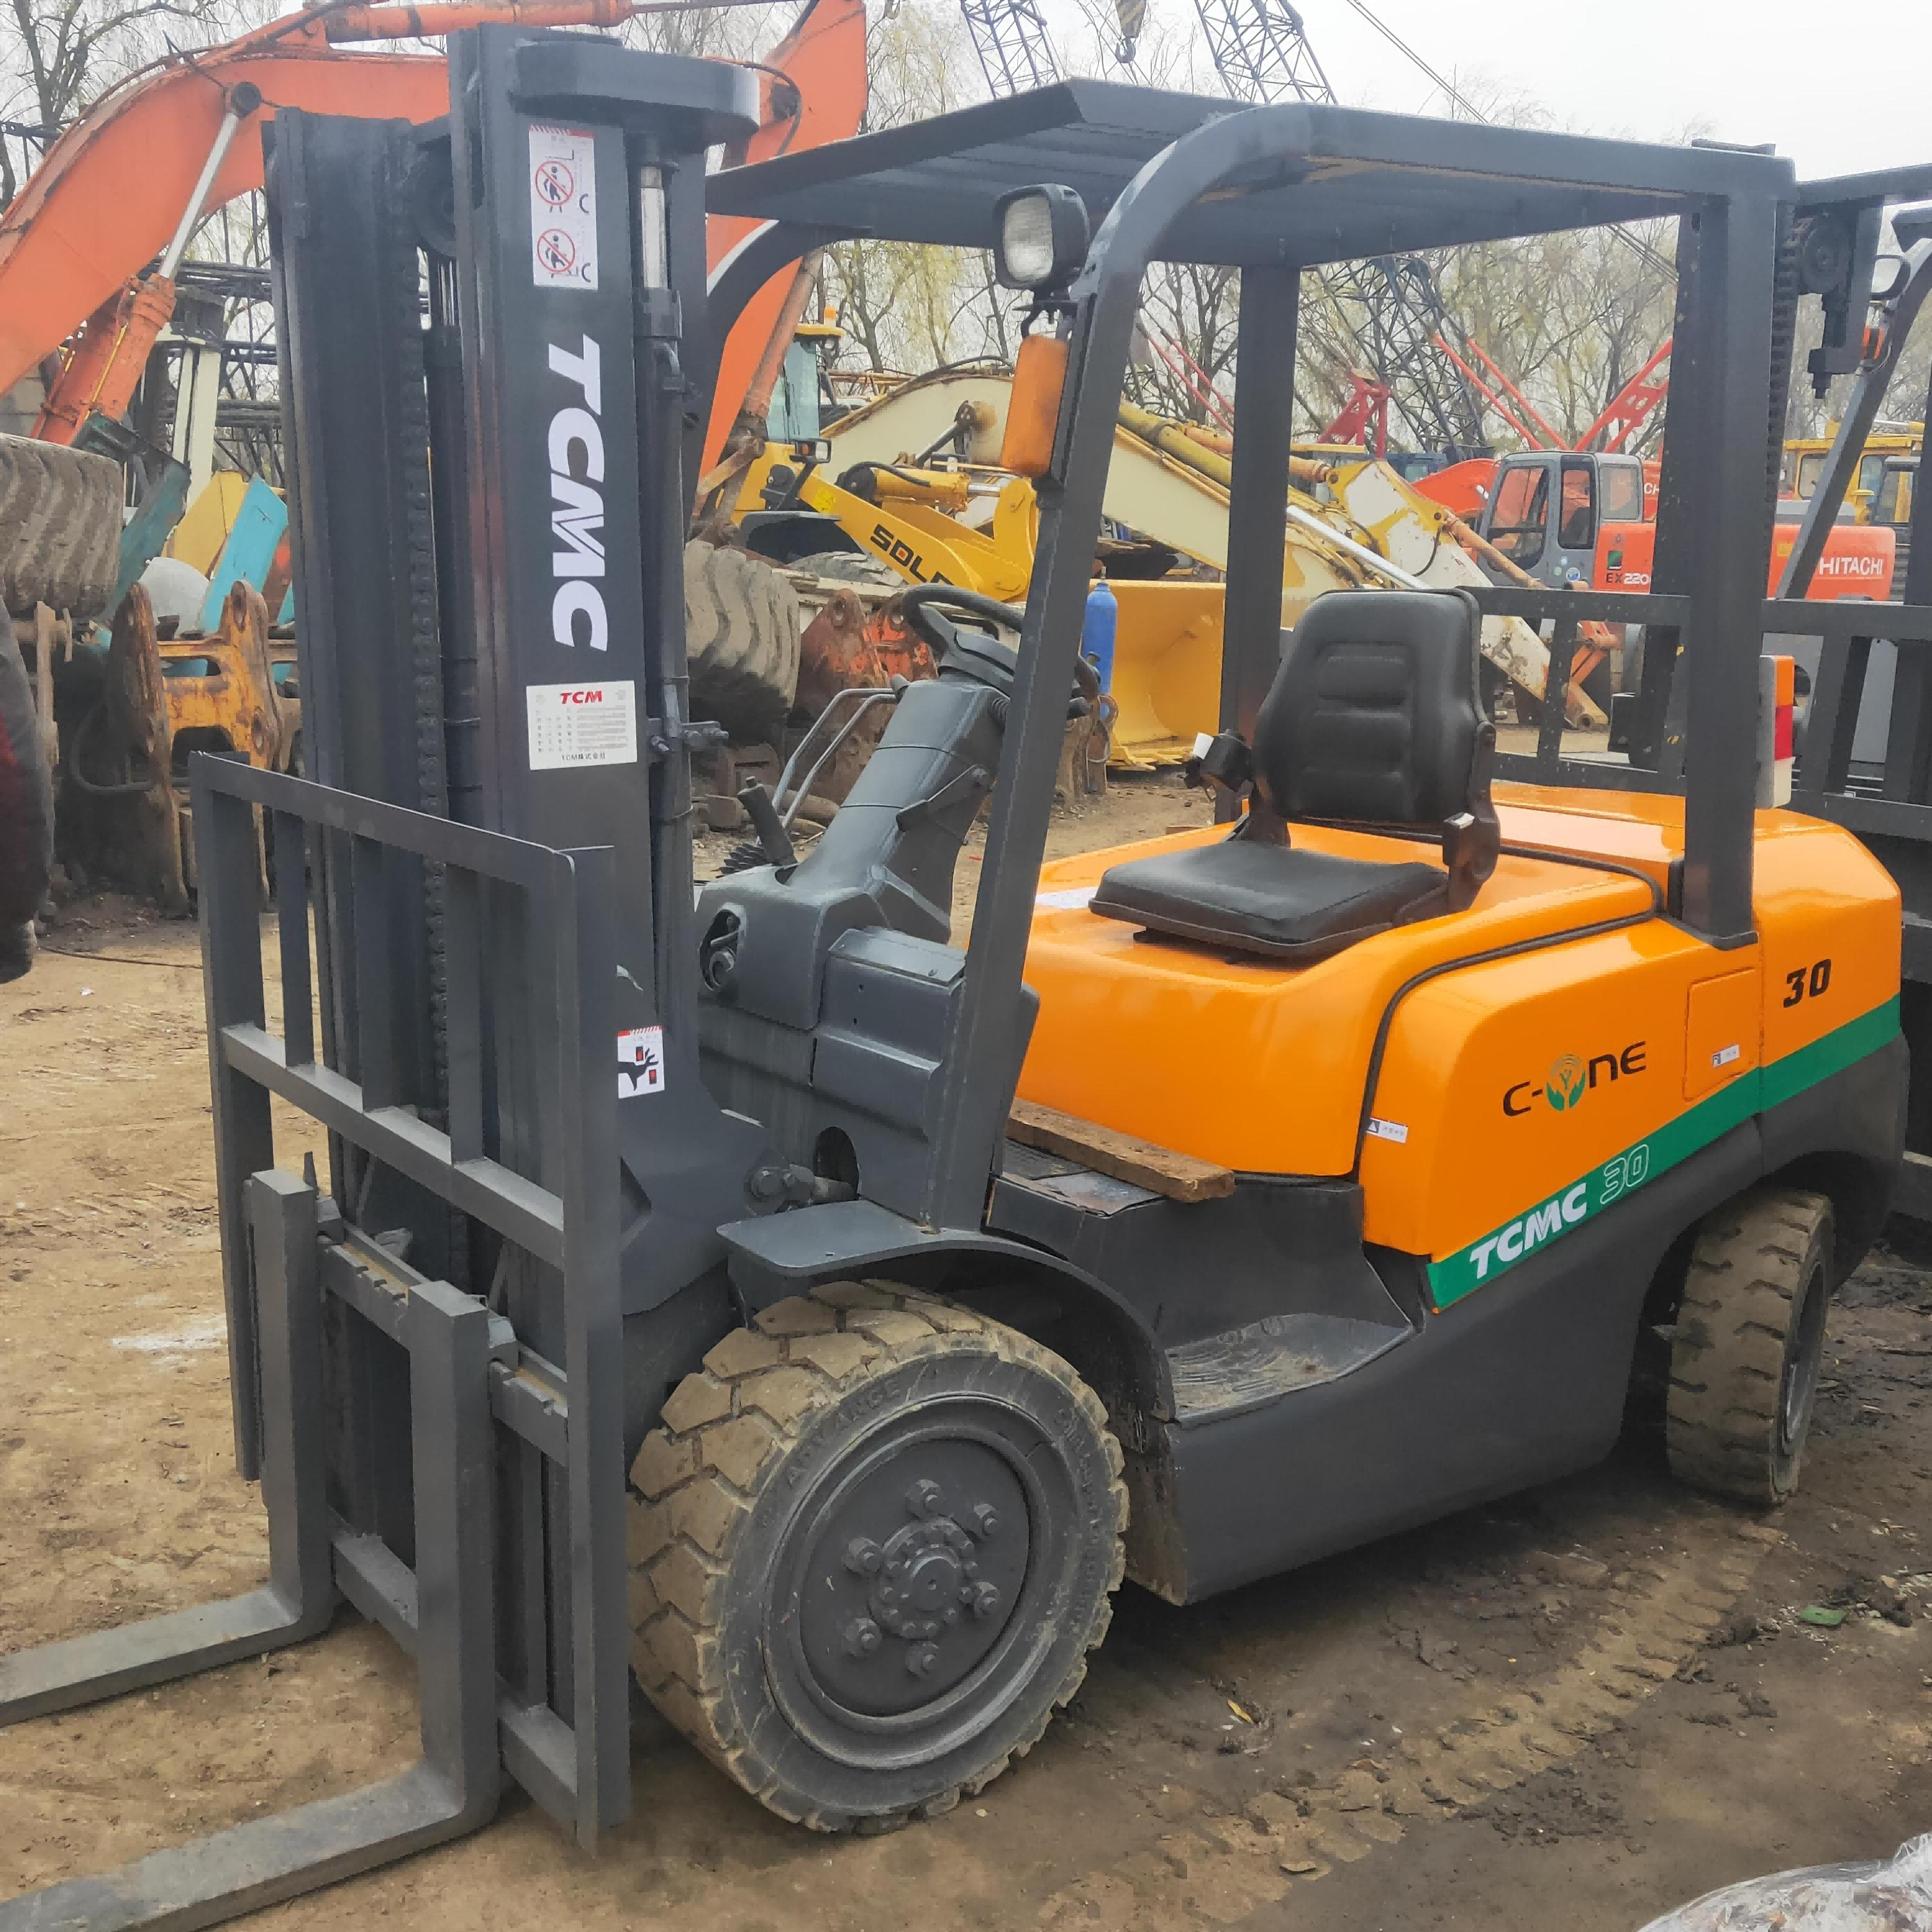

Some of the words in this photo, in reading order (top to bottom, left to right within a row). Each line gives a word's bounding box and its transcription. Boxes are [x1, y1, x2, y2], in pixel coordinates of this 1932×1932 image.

[548, 333, 608, 652] TCMC
[1819, 556, 1883, 576] HITACHI
[560, 690, 603, 704] TCM
[1783, 958, 1831, 1008] 30
[1469, 1182, 1587, 1279] TCMC
[1600, 1144, 1649, 1204] 30
